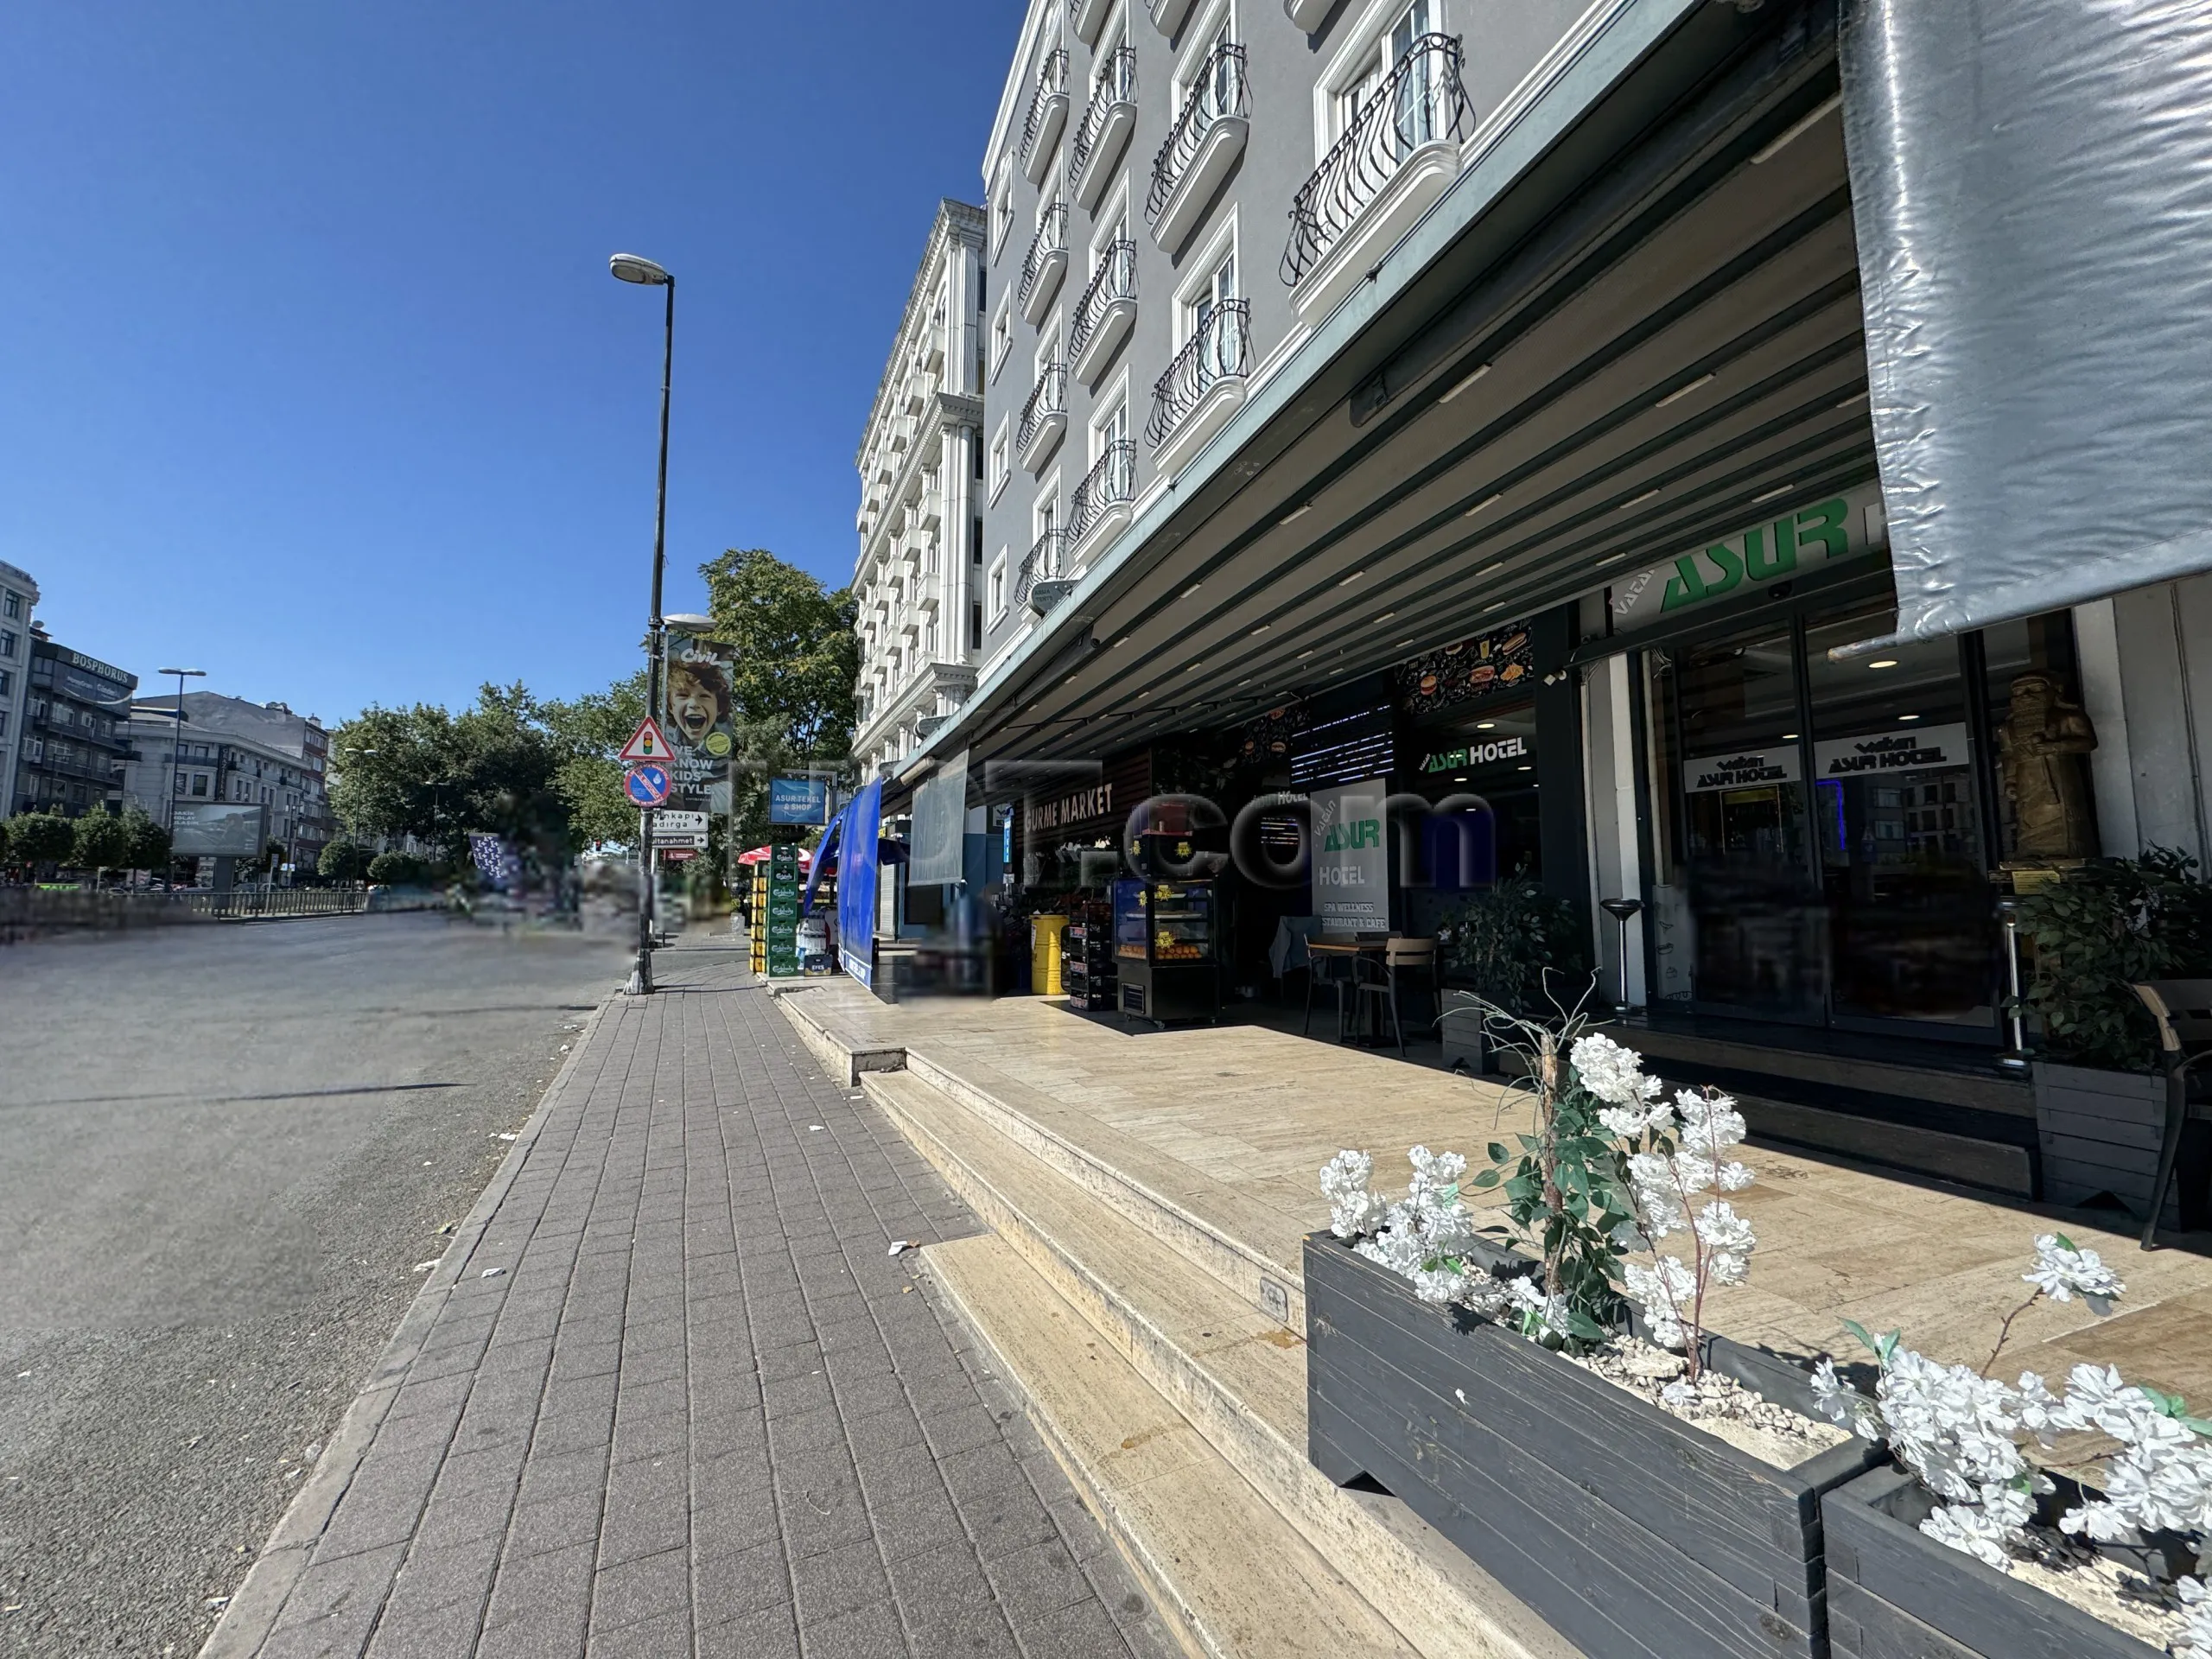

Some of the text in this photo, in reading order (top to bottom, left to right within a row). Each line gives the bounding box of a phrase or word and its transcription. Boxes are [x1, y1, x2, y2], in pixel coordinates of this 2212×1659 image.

[1661, 498, 1848, 613] ASUR
[72, 652, 129, 683] BOSPHORUS
[1428, 736, 1527, 773] ASUR HOTEL
[1828, 747, 1947, 773] ASUR HOTEL
[1697, 765, 1787, 788] ASUR HOTEL
[775, 794, 821, 804] ASUR TEKEL
[1025, 783, 1113, 833] GURME MARKET
[1277, 791, 1309, 805] HOTEL
[1324, 818, 1380, 853] ASUR
[1319, 865, 1365, 887] HOTEL
[1324, 901, 1374, 913] SPA WELLNESS
[1322, 916, 1357, 928] STAURANT
[1365, 917, 1386, 929] CAFE
